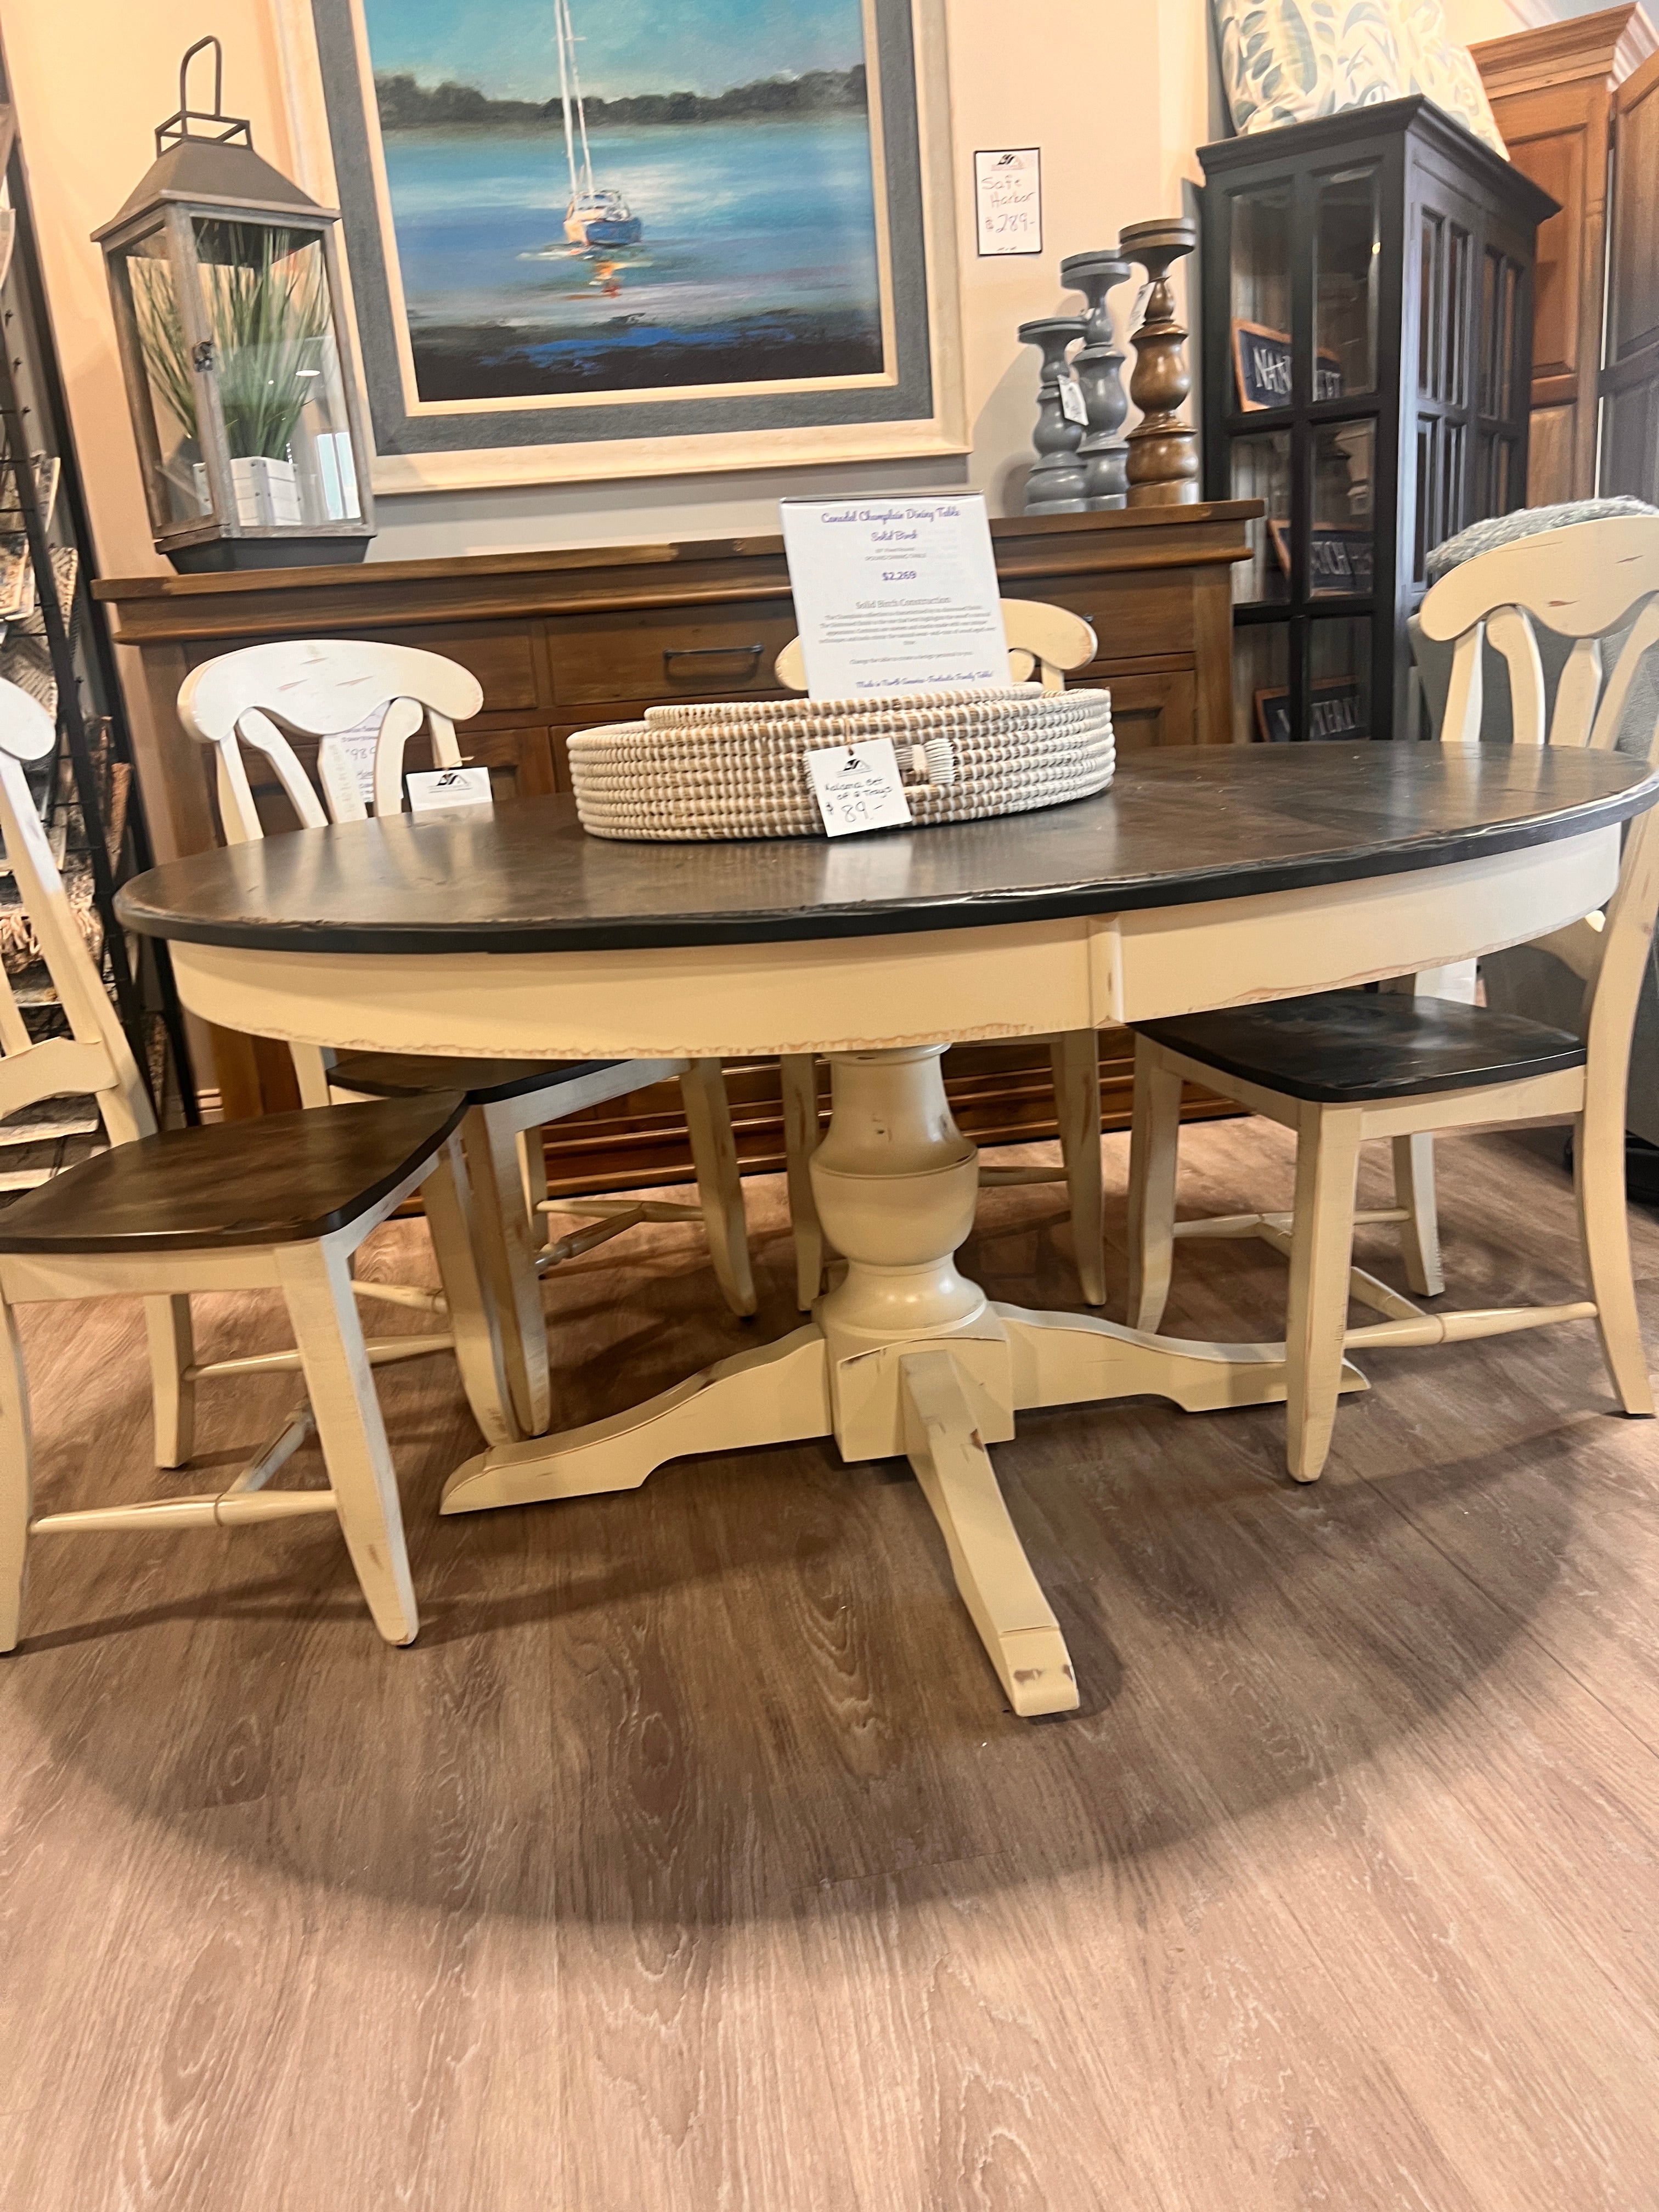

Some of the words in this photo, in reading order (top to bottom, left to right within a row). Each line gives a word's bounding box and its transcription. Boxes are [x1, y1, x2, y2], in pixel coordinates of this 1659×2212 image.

[981, 174, 1022, 190] Safe
[990, 191, 1036, 208] Harbor
[906, 508, 935, 522] Dining
[936, 506, 961, 517] Table
[871, 530, 894, 541] Solid
[882, 571, 917, 581] $2,269
